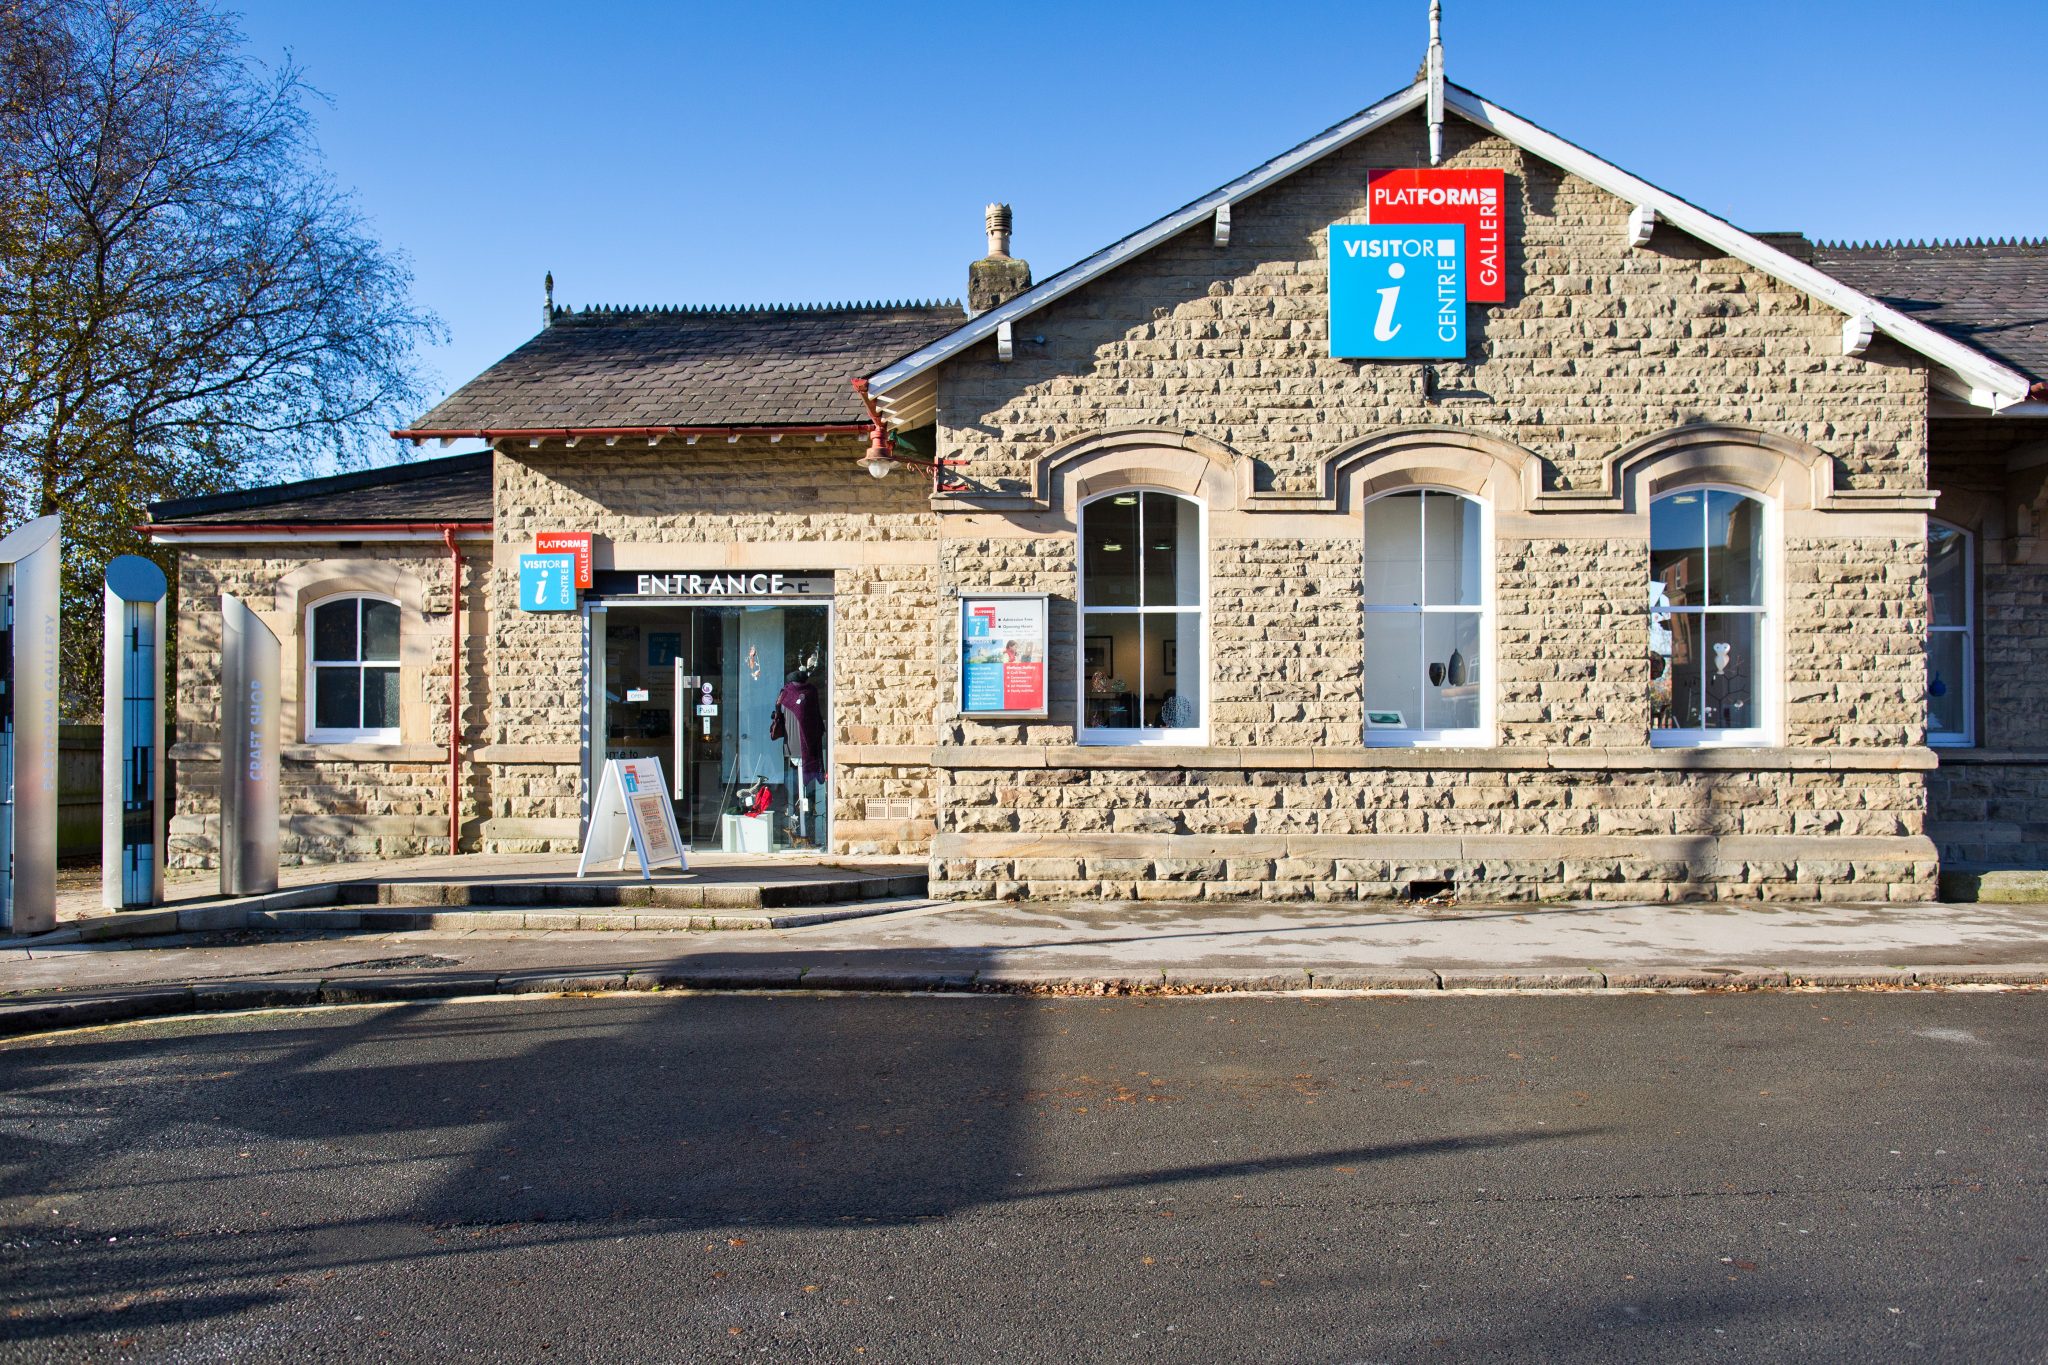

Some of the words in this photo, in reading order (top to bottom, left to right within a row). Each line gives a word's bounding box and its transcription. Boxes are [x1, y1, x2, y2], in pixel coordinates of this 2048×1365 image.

[1375, 187, 1478, 205] PLATFORM
[1343, 239, 1435, 257] VISITOR
[1480, 188, 1497, 285] GALLERY
[1437, 259, 1456, 342] CENTRE
[538, 539, 581, 549] PLATFORM
[523, 560, 560, 569] VISITOR
[561, 568, 569, 604] CENTRE
[637, 574, 783, 595] ENTRANCE
[250, 680, 265, 725] SHOP
[249, 730, 264, 781] CRAFT
